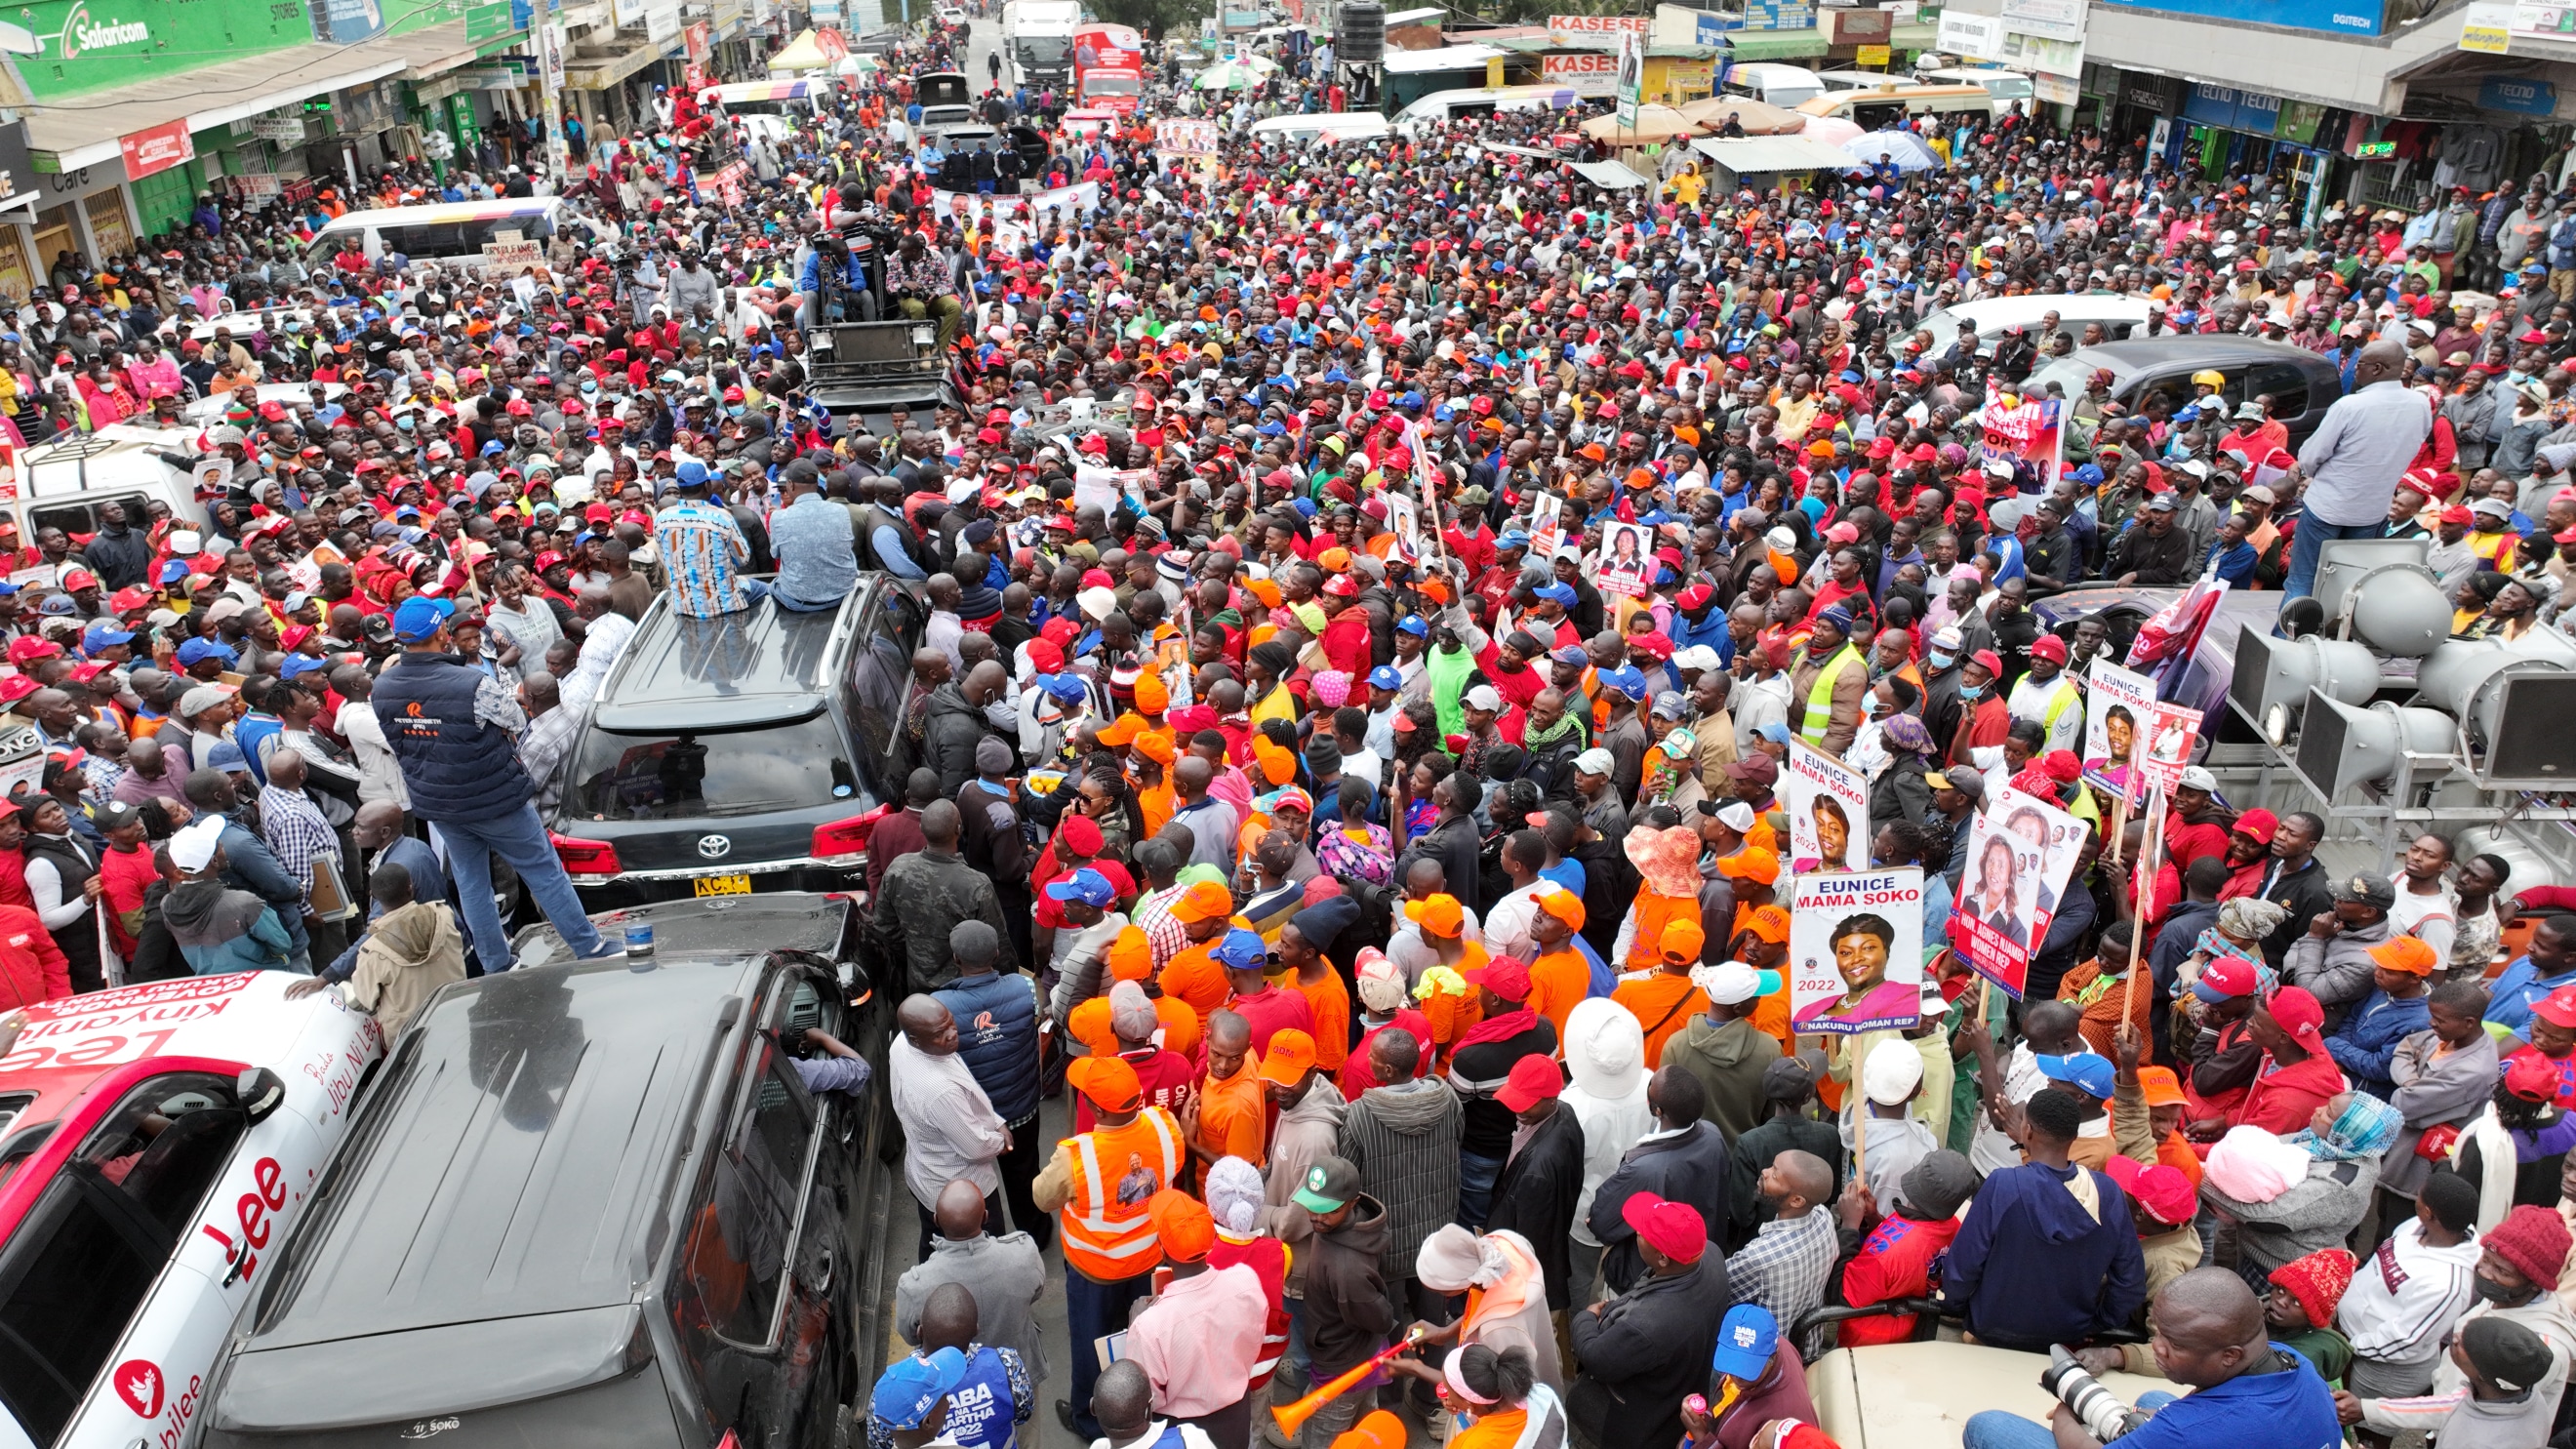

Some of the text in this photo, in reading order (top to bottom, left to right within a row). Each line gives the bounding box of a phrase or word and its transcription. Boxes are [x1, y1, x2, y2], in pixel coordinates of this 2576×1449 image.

[270, 3, 300, 21] STORES
[2332, 13, 2371, 29] DGITECH
[1550, 16, 1649, 31] KASESE
[1945, 20, 1986, 37] NAKURU NAIROBI
[77, 19, 148, 50] Safaricom
[1947, 40, 1979, 54] BOOKING OFFICE
[2196, 83, 2233, 103] TECNO
[2498, 82, 2535, 100] TECNO
[2240, 91, 2282, 112] TECNO
[1610, 569, 1636, 581] AGNES
[2091, 678, 2120, 699] MAMA
[2123, 694, 2153, 711] SOKO
[2103, 673, 2142, 697] EUNICE
[0, 732, 37, 758] ONG
[2088, 738, 2108, 753] 2022
[1804, 753, 1849, 786] EUNICE
[1791, 758, 1864, 806] MAMA SOKO
[2089, 774, 2111, 789] NAKURU
[1992, 796, 2014, 810] Jubilee
[1794, 833, 1817, 853] 2022
[1819, 876, 1895, 894] EUNICE
[1795, 889, 1919, 908] MAMA SOKO
[1756, 908, 1783, 929] ODM
[2033, 907, 2048, 927] MBI
[1960, 911, 2025, 964] HON. AGNES NJAMBI
[1970, 935, 2010, 970] WOMEN REP
[1972, 950, 2005, 978] NAKURU COUNTY
[30, 971, 256, 1012] NAKURU COUNTY
[1797, 980, 1835, 991] 2022
[976, 1026, 1000, 1038] AZIMIO
[1807, 1018, 1914, 1032] NAKURU WOMAN REP
[355, 1017, 378, 1055] Lee
[978, 1034, 1004, 1045] UMOJA
[0, 1027, 178, 1072] Lee
[345, 1039, 364, 1075] Ni
[1272, 1045, 1295, 1059] ODM
[327, 1067, 354, 1115] Jibu
[2149, 1076, 2174, 1086] ODM
[202, 1156, 287, 1284] Lee
[1114, 1205, 1136, 1216] TUKO
[1735, 1326, 1756, 1336] BABA
[914, 1393, 931, 1413] #5
[946, 1382, 993, 1410] ABA
[158, 1374, 202, 1449] bilee
[954, 1407, 969, 1417] NA
[429, 1419, 460, 1431] SOKO
